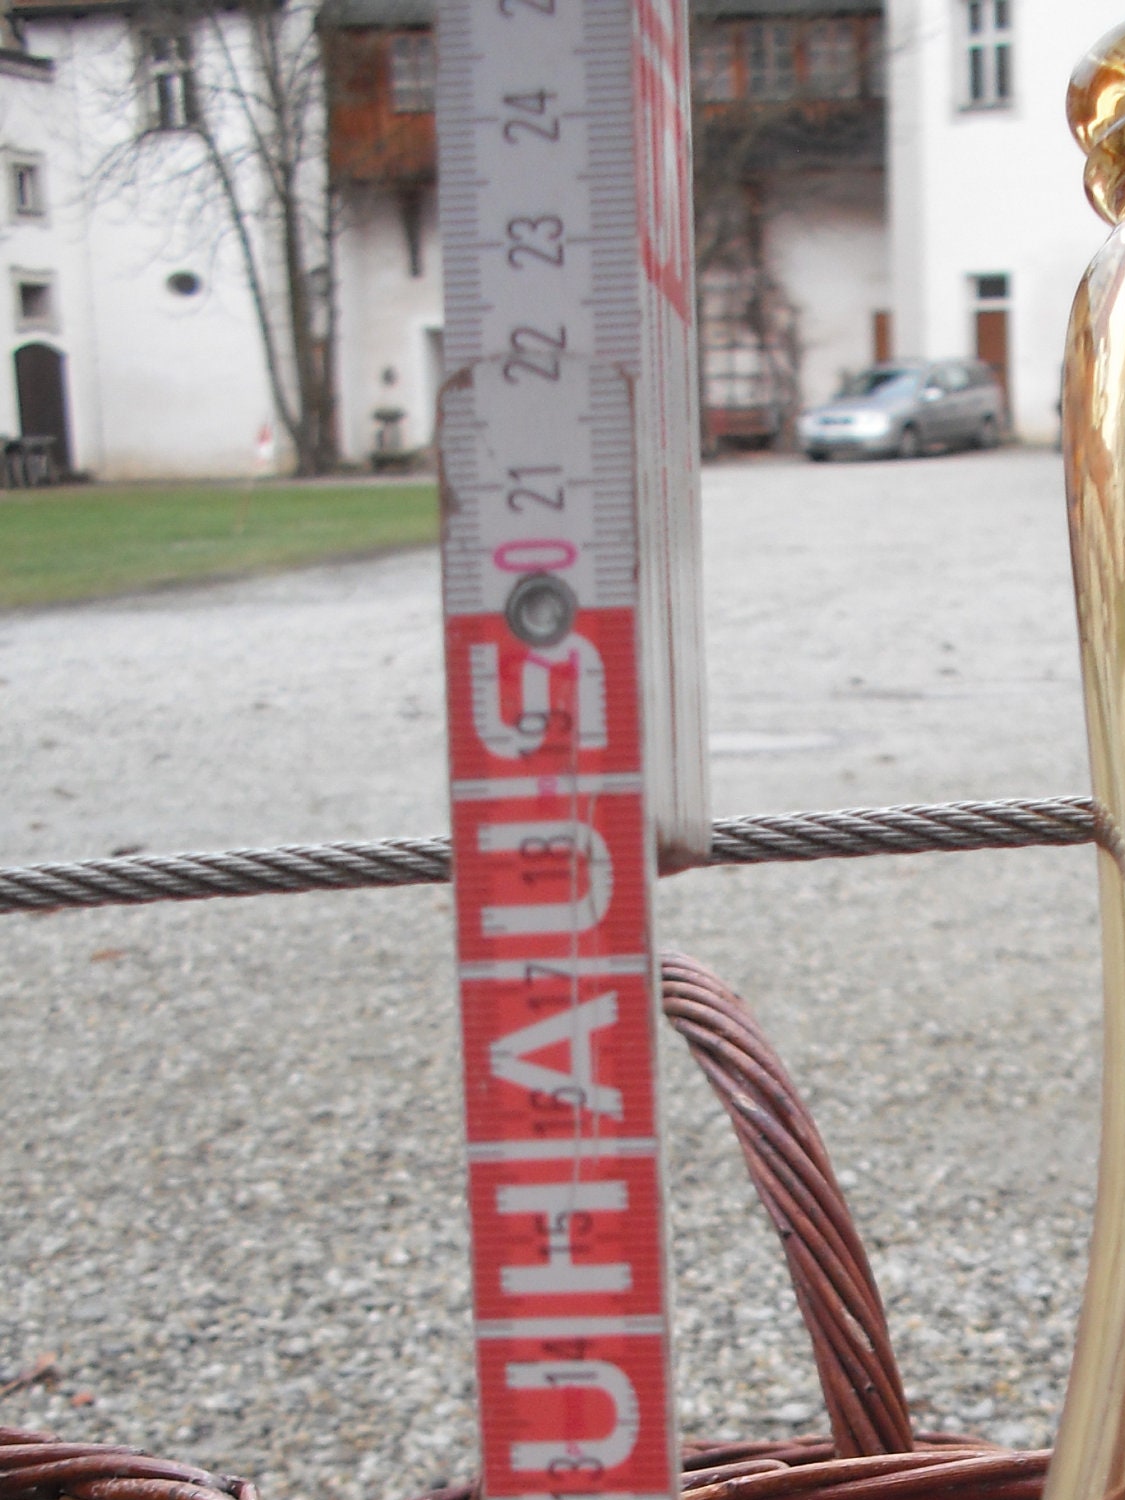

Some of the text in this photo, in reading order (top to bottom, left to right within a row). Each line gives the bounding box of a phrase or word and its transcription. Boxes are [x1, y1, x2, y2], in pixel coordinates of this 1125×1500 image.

[503, 87, 560, 144] 24
[508, 213, 566, 269] 23
[503, 324, 567, 385] 22
[507, 465, 566, 512] 21
[513, 710, 573, 759] 19
[519, 835, 575, 886] 18
[531, 1085, 588, 1137] 16
[534, 1210, 594, 1258] 15
